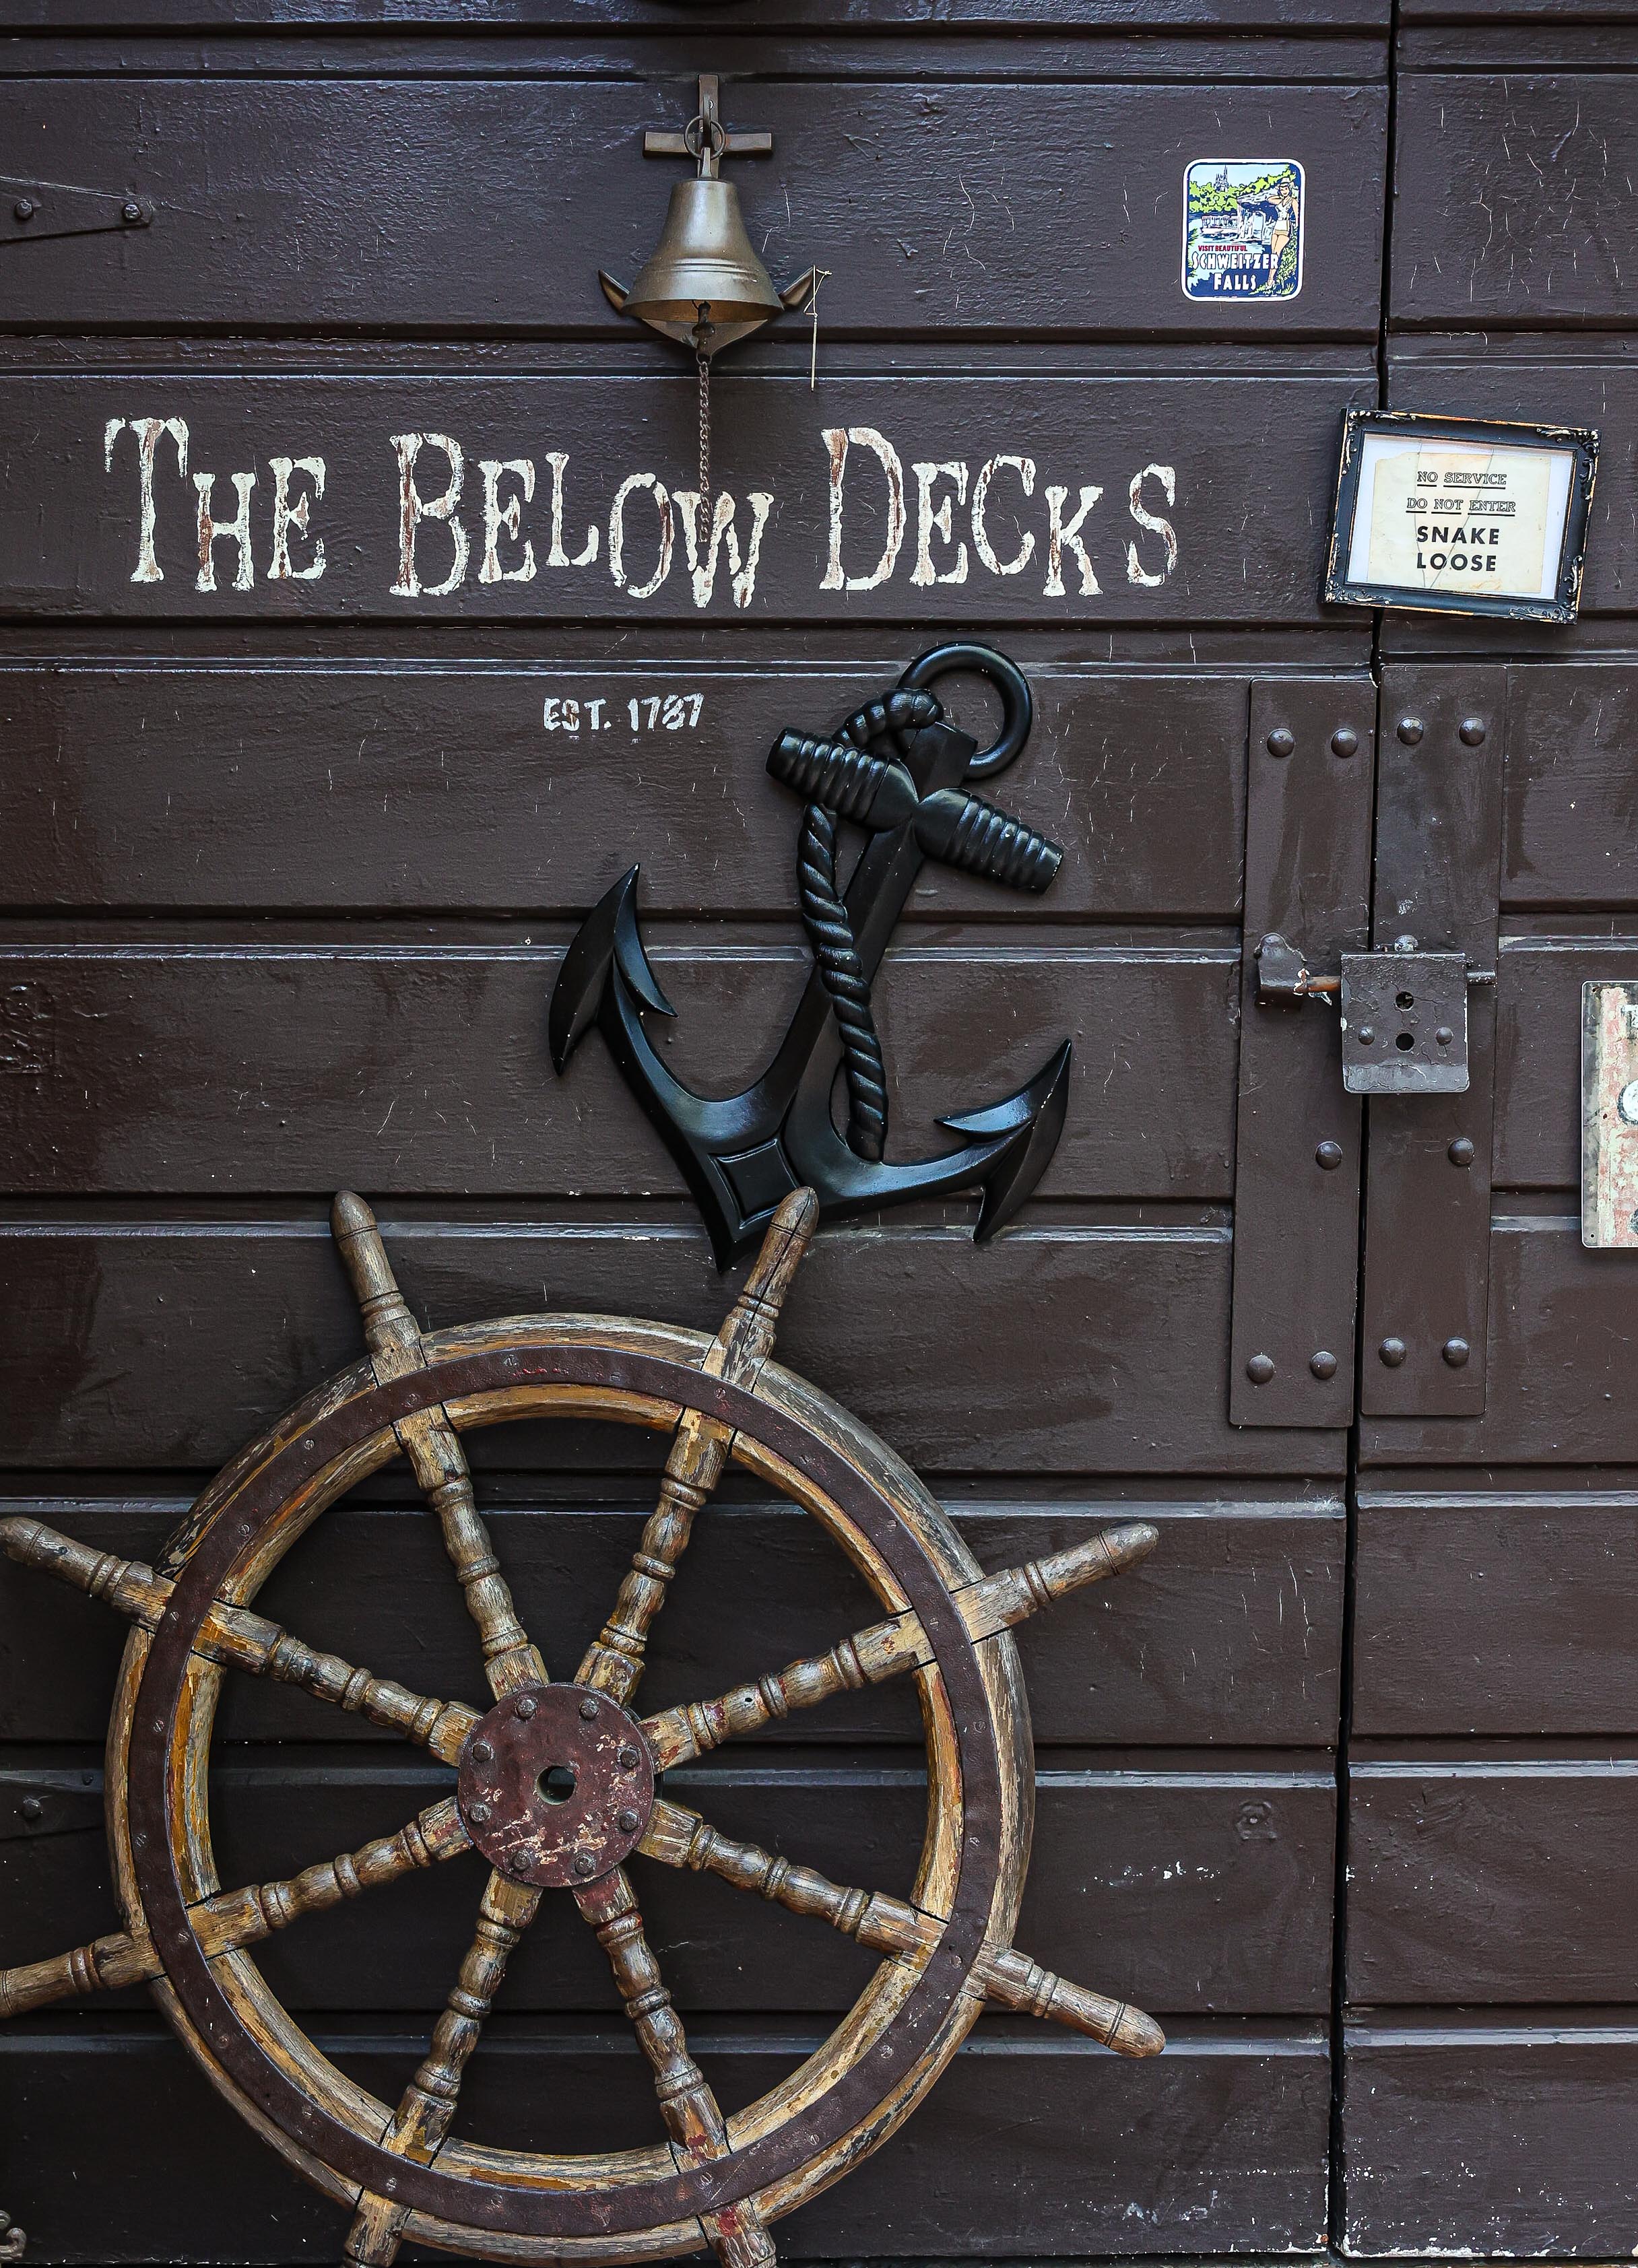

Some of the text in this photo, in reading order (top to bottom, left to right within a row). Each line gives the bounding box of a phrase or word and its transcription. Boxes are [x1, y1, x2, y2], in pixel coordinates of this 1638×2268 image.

[1191, 251, 1279, 269] SCHWEITZER
[1213, 272, 1257, 290] FALLS
[1416, 471, 1507, 485] NO SERVICE
[103, 416, 1178, 609] THE BELOW DECKS
[1406, 497, 1516, 512] DO NOT ENTER
[1416, 525, 1500, 545] SNAKE
[1416, 552, 1497, 572] LOOSE
[544, 692, 705, 732] EST. 1787
